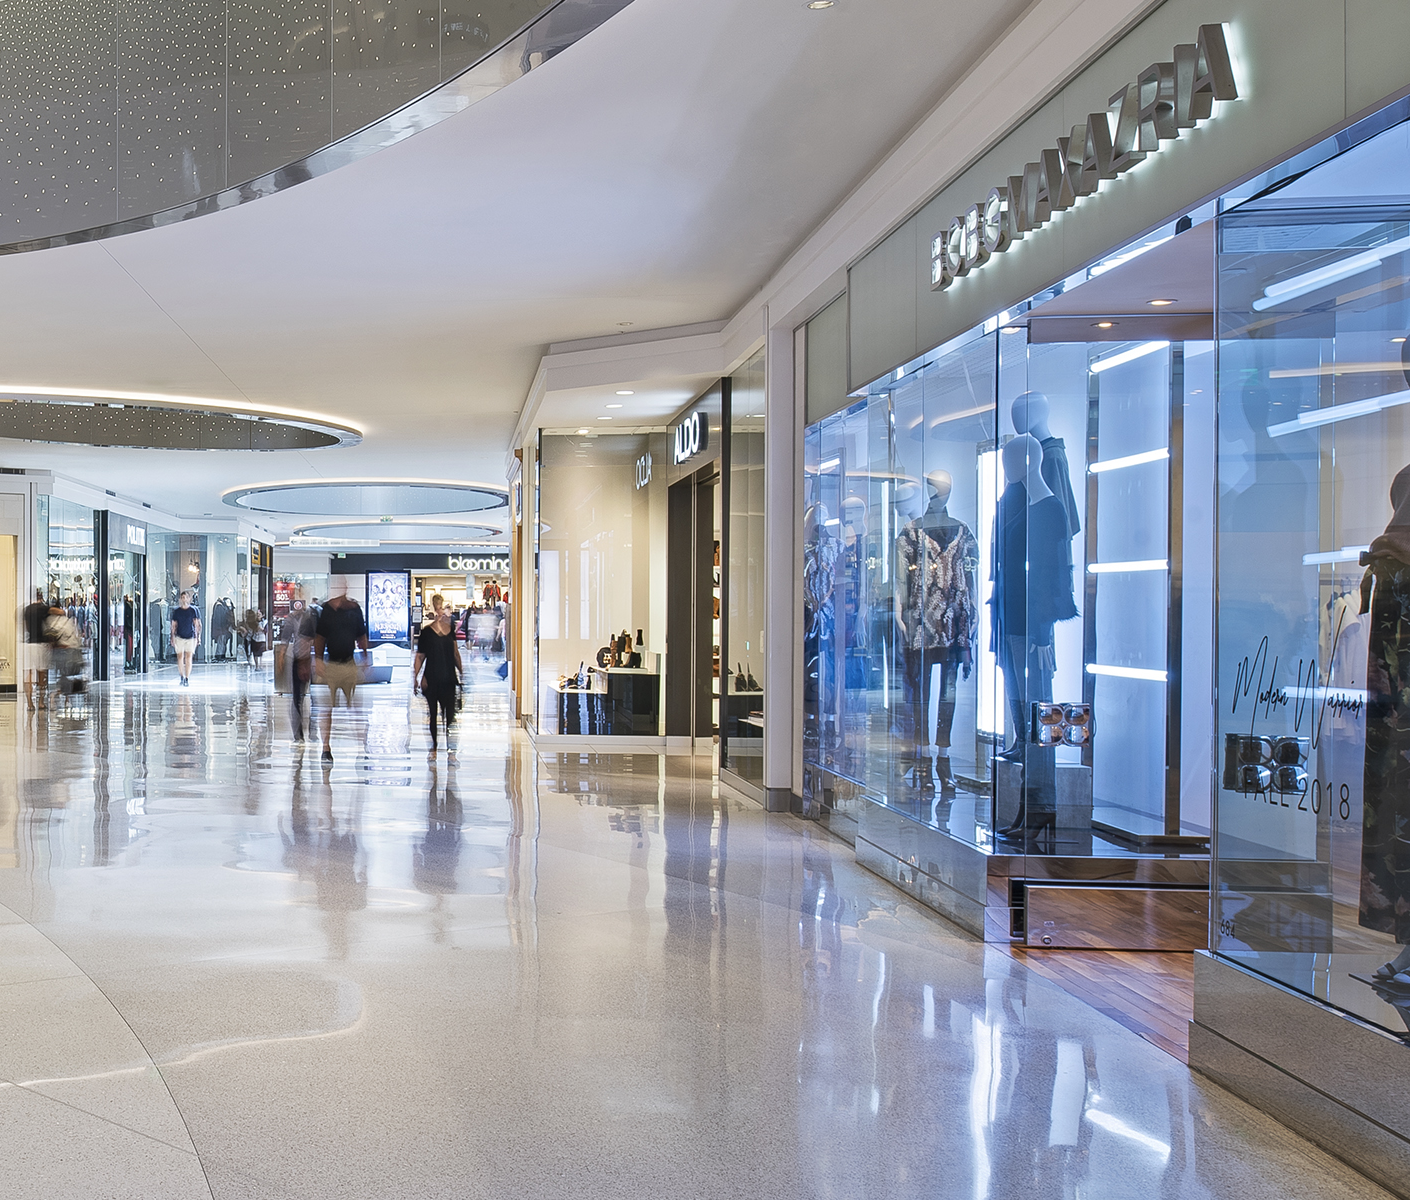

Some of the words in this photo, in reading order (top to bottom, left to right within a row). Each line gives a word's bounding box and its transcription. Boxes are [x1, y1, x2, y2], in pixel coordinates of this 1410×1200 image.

[673, 411, 700, 466] ALDO
[1244, 768, 1290, 808] FALL
[1297, 777, 1351, 821] 2018
[1220, 919, 1236, 940] 684
